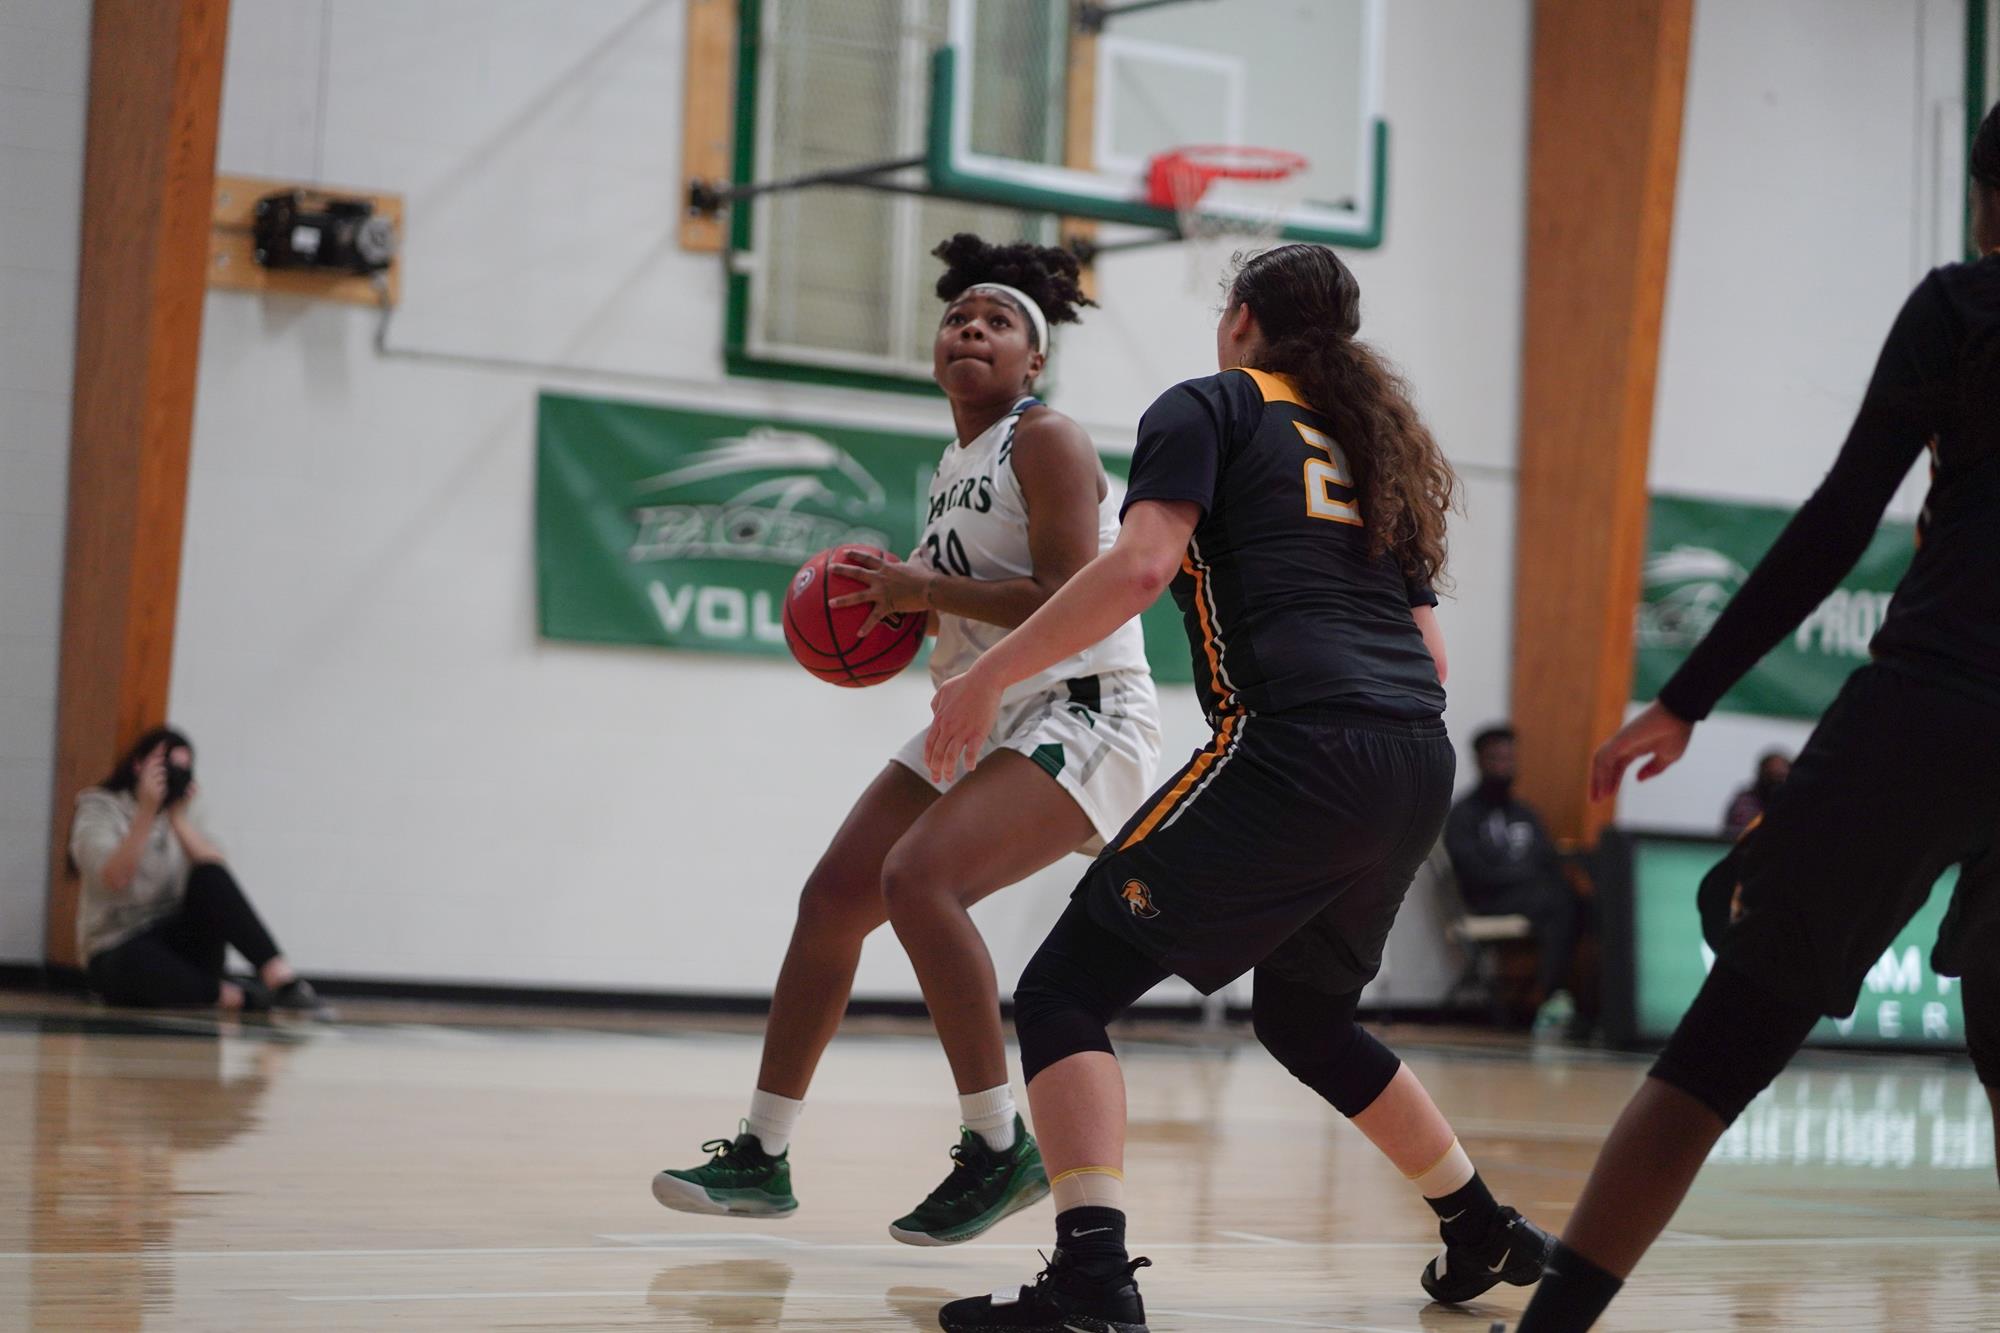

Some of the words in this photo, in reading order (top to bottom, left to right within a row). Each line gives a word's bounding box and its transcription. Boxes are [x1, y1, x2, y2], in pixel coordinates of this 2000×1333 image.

[1292, 420, 1364, 528] 2
[927, 475, 992, 525] ACRS
[927, 528, 972, 577] 30
